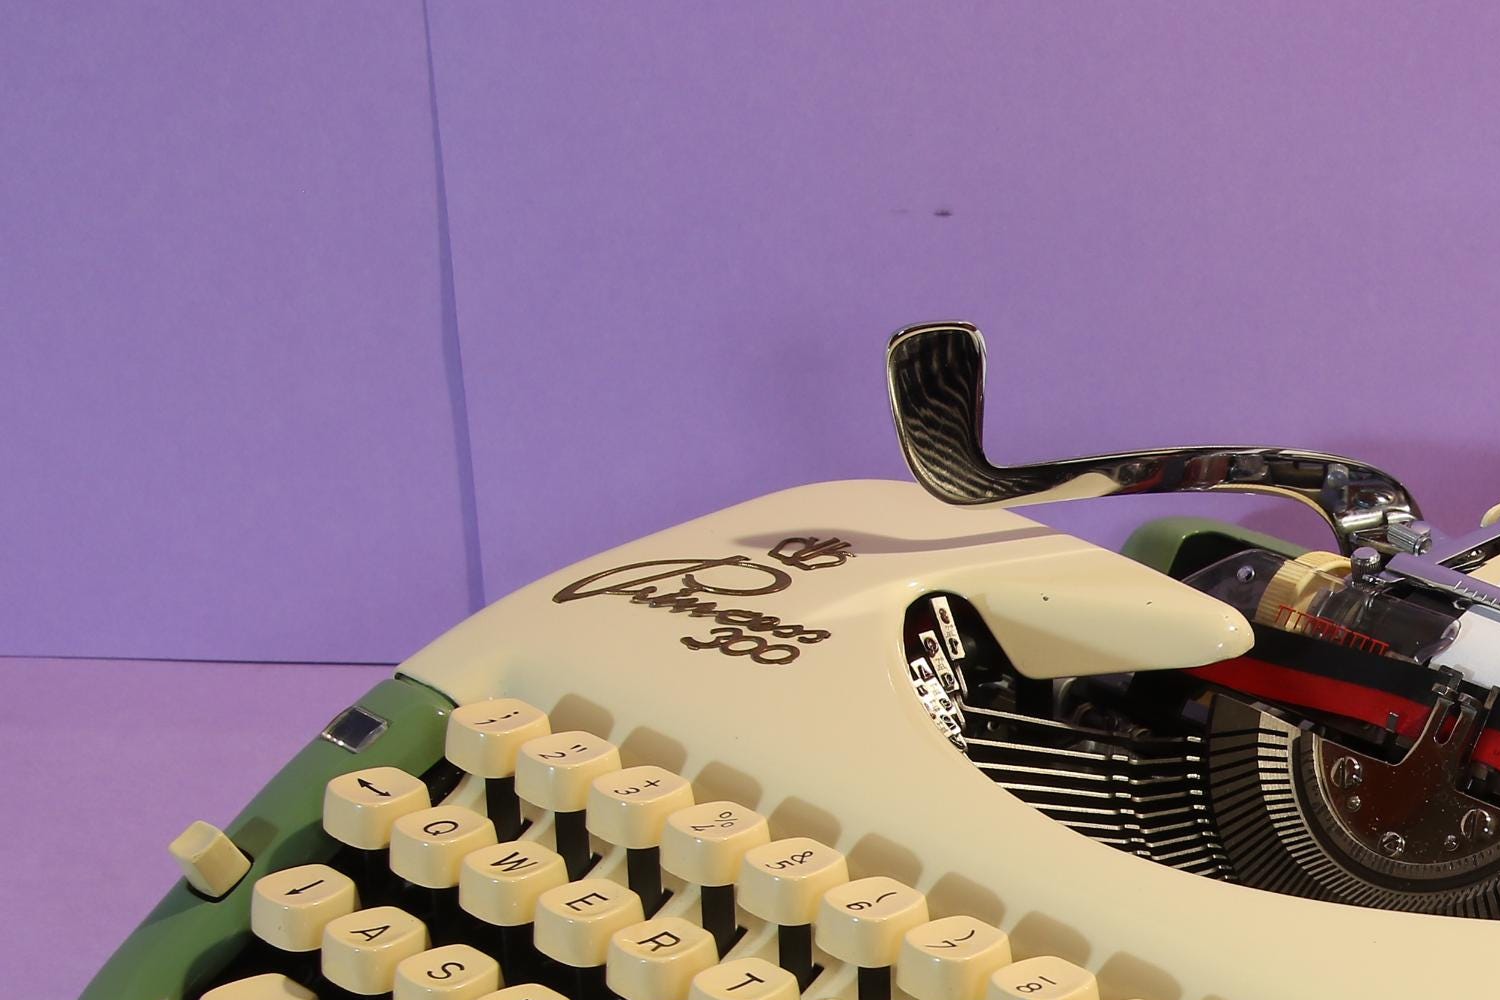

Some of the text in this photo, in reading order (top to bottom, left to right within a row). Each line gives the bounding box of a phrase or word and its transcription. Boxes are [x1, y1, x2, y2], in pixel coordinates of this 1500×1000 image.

[551, 555, 831, 644] Princess
[680, 627, 801, 665] 300
[538, 751, 567, 760] 2
[614, 787, 640, 796] 3
[423, 820, 459, 836] Q
[690, 824, 715, 832] 4
[714, 811, 739, 829] %
[489, 851, 538, 878] W
[765, 860, 794, 870] 5
[790, 850, 814, 865] &
[564, 892, 611, 912] E
[846, 901, 873, 911] 6
[349, 924, 391, 947] A
[636, 930, 681, 953] R
[925, 939, 957, 948] 7
[426, 961, 465, 981] S
[725, 972, 765, 992] T
[1015, 982, 1043, 993] 8
